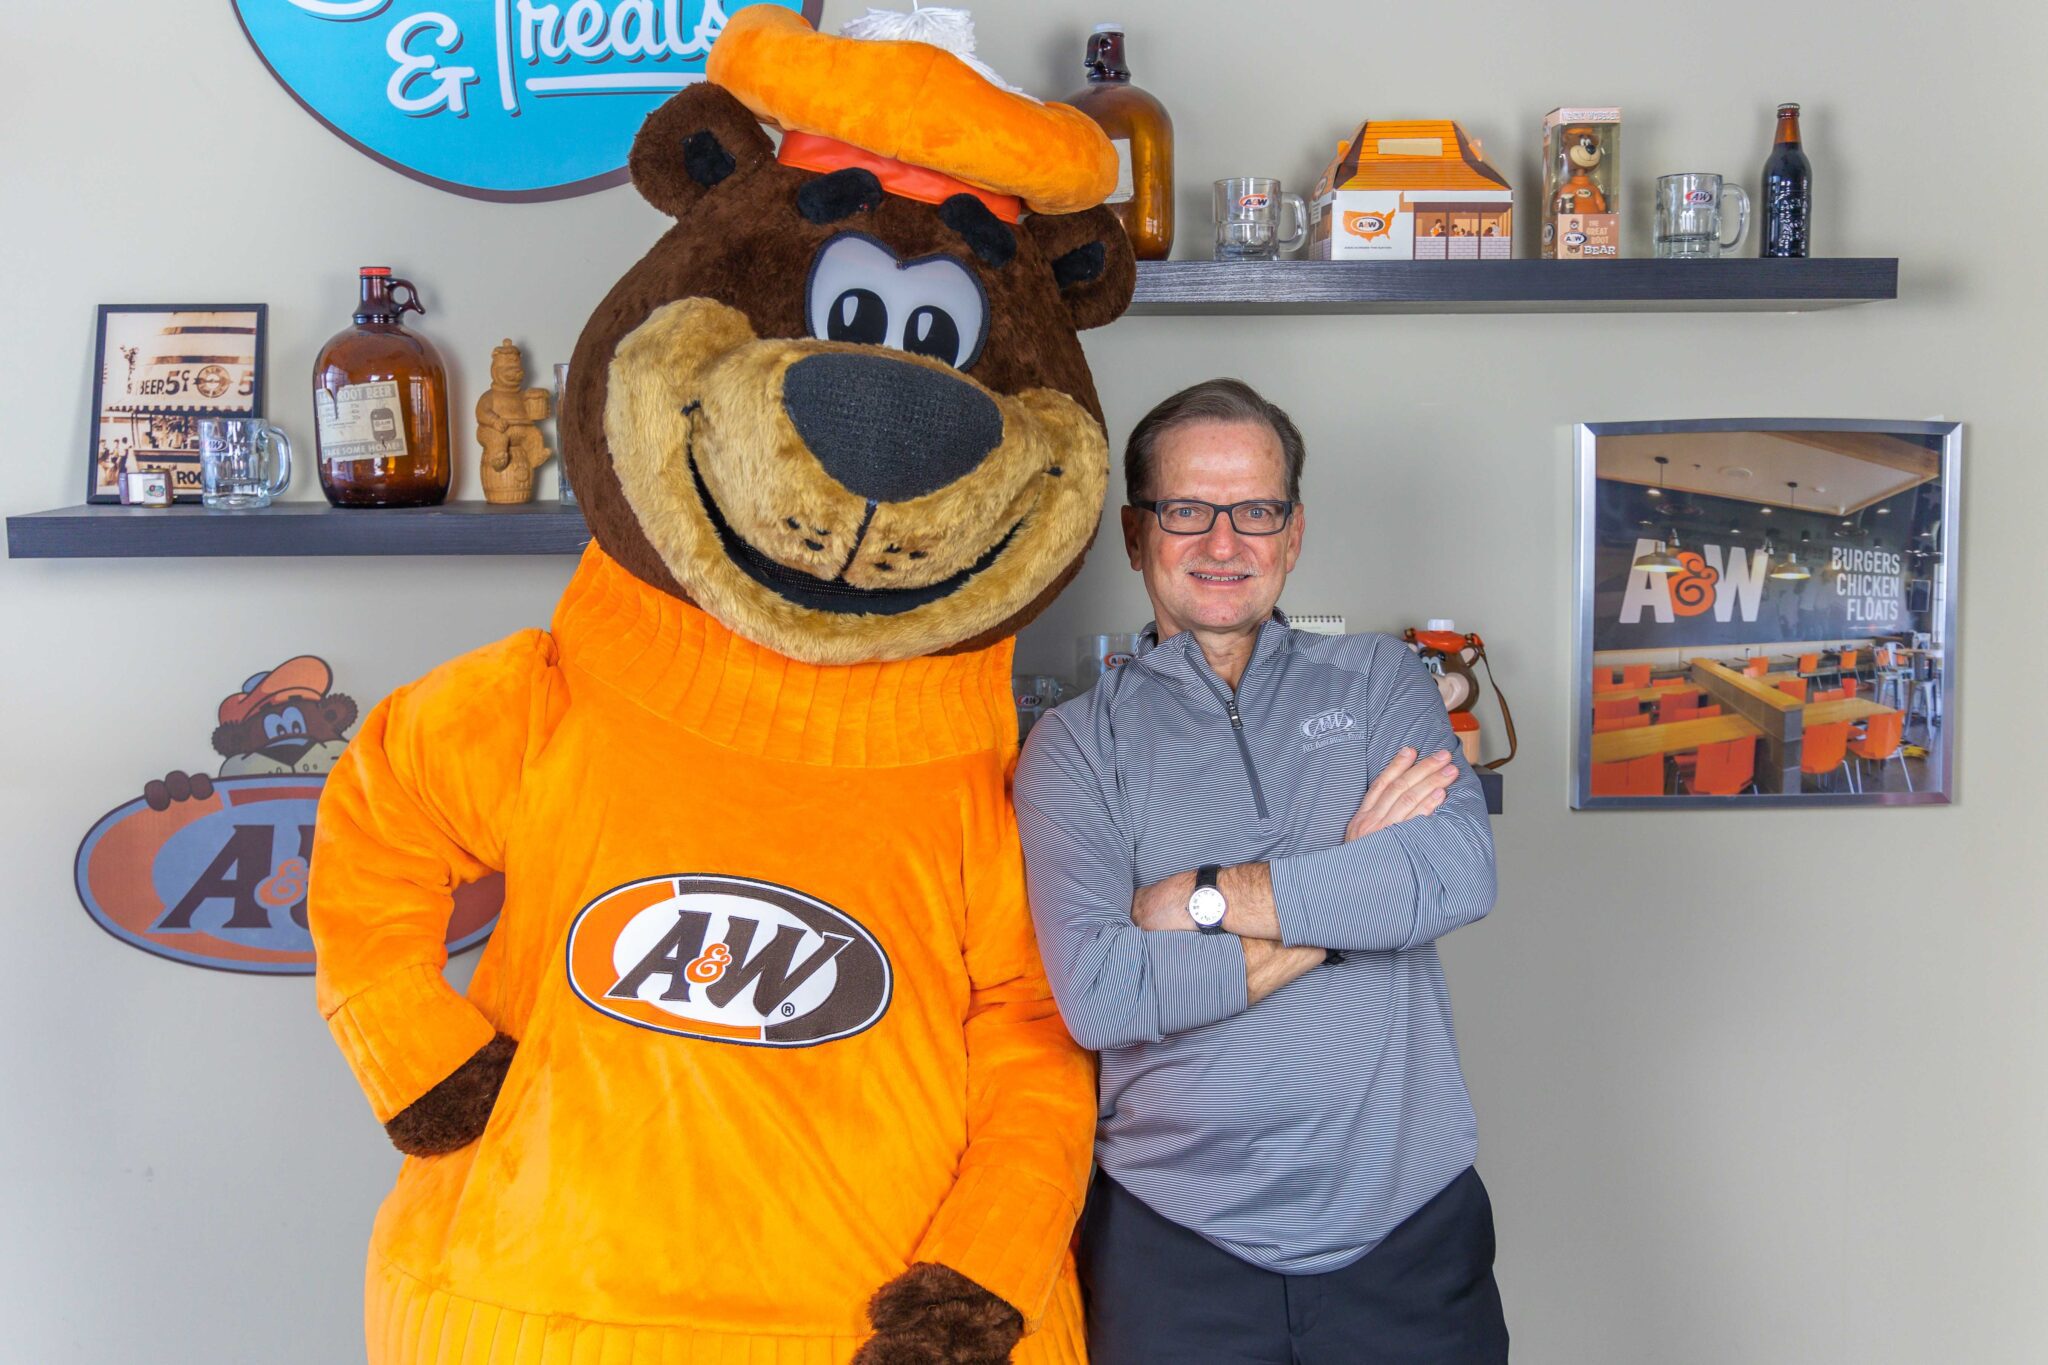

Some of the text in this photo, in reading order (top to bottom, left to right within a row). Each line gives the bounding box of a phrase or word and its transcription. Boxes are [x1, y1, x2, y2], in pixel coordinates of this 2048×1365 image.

[386, 12, 475, 112] &
[1584, 245, 1617, 255] BEAR
[1619, 538, 1769, 624] A&W
[1831, 546, 1901, 575] BURGERS
[1836, 572, 1900, 599] CHICKEN
[1846, 596, 1899, 622] FLOATS
[157, 824, 315, 929] A&
[606, 909, 852, 1018] A&W
